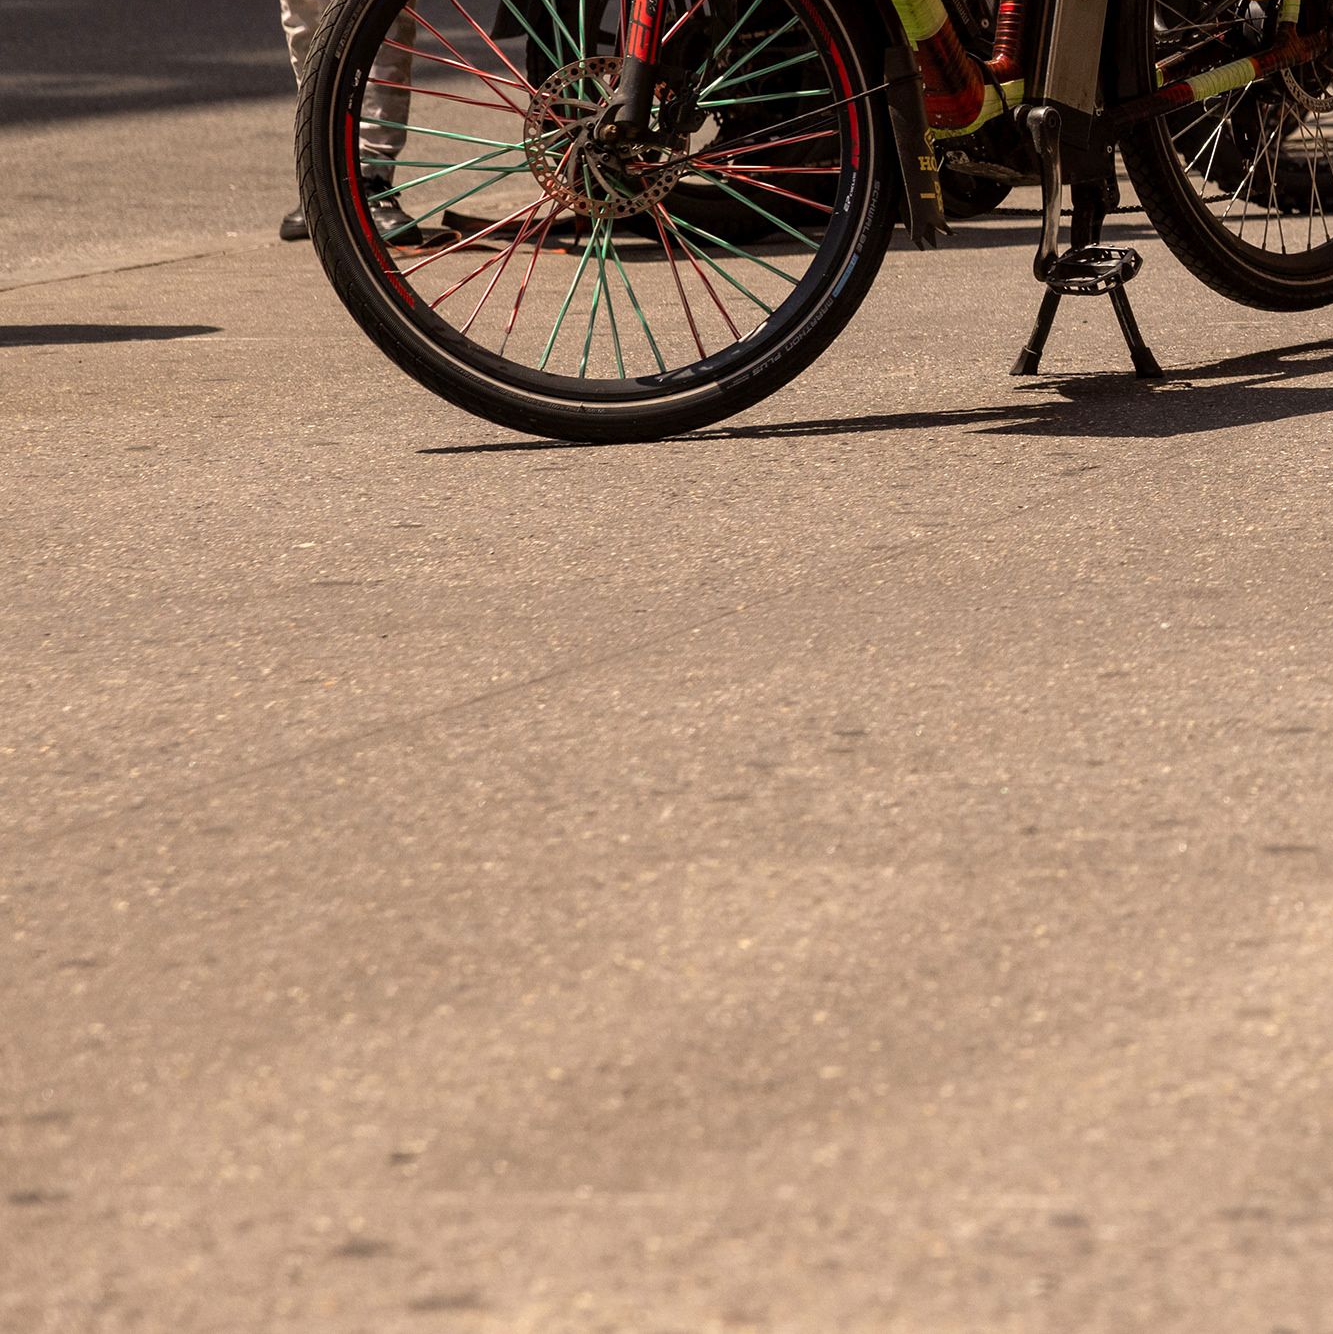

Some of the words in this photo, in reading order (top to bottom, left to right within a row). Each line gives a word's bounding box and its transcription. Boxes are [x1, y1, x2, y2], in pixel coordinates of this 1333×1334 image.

[856, 179, 881, 253] SCHWALBE
[786, 297, 834, 352] MARATHON
[752, 352, 782, 377] PLUS
